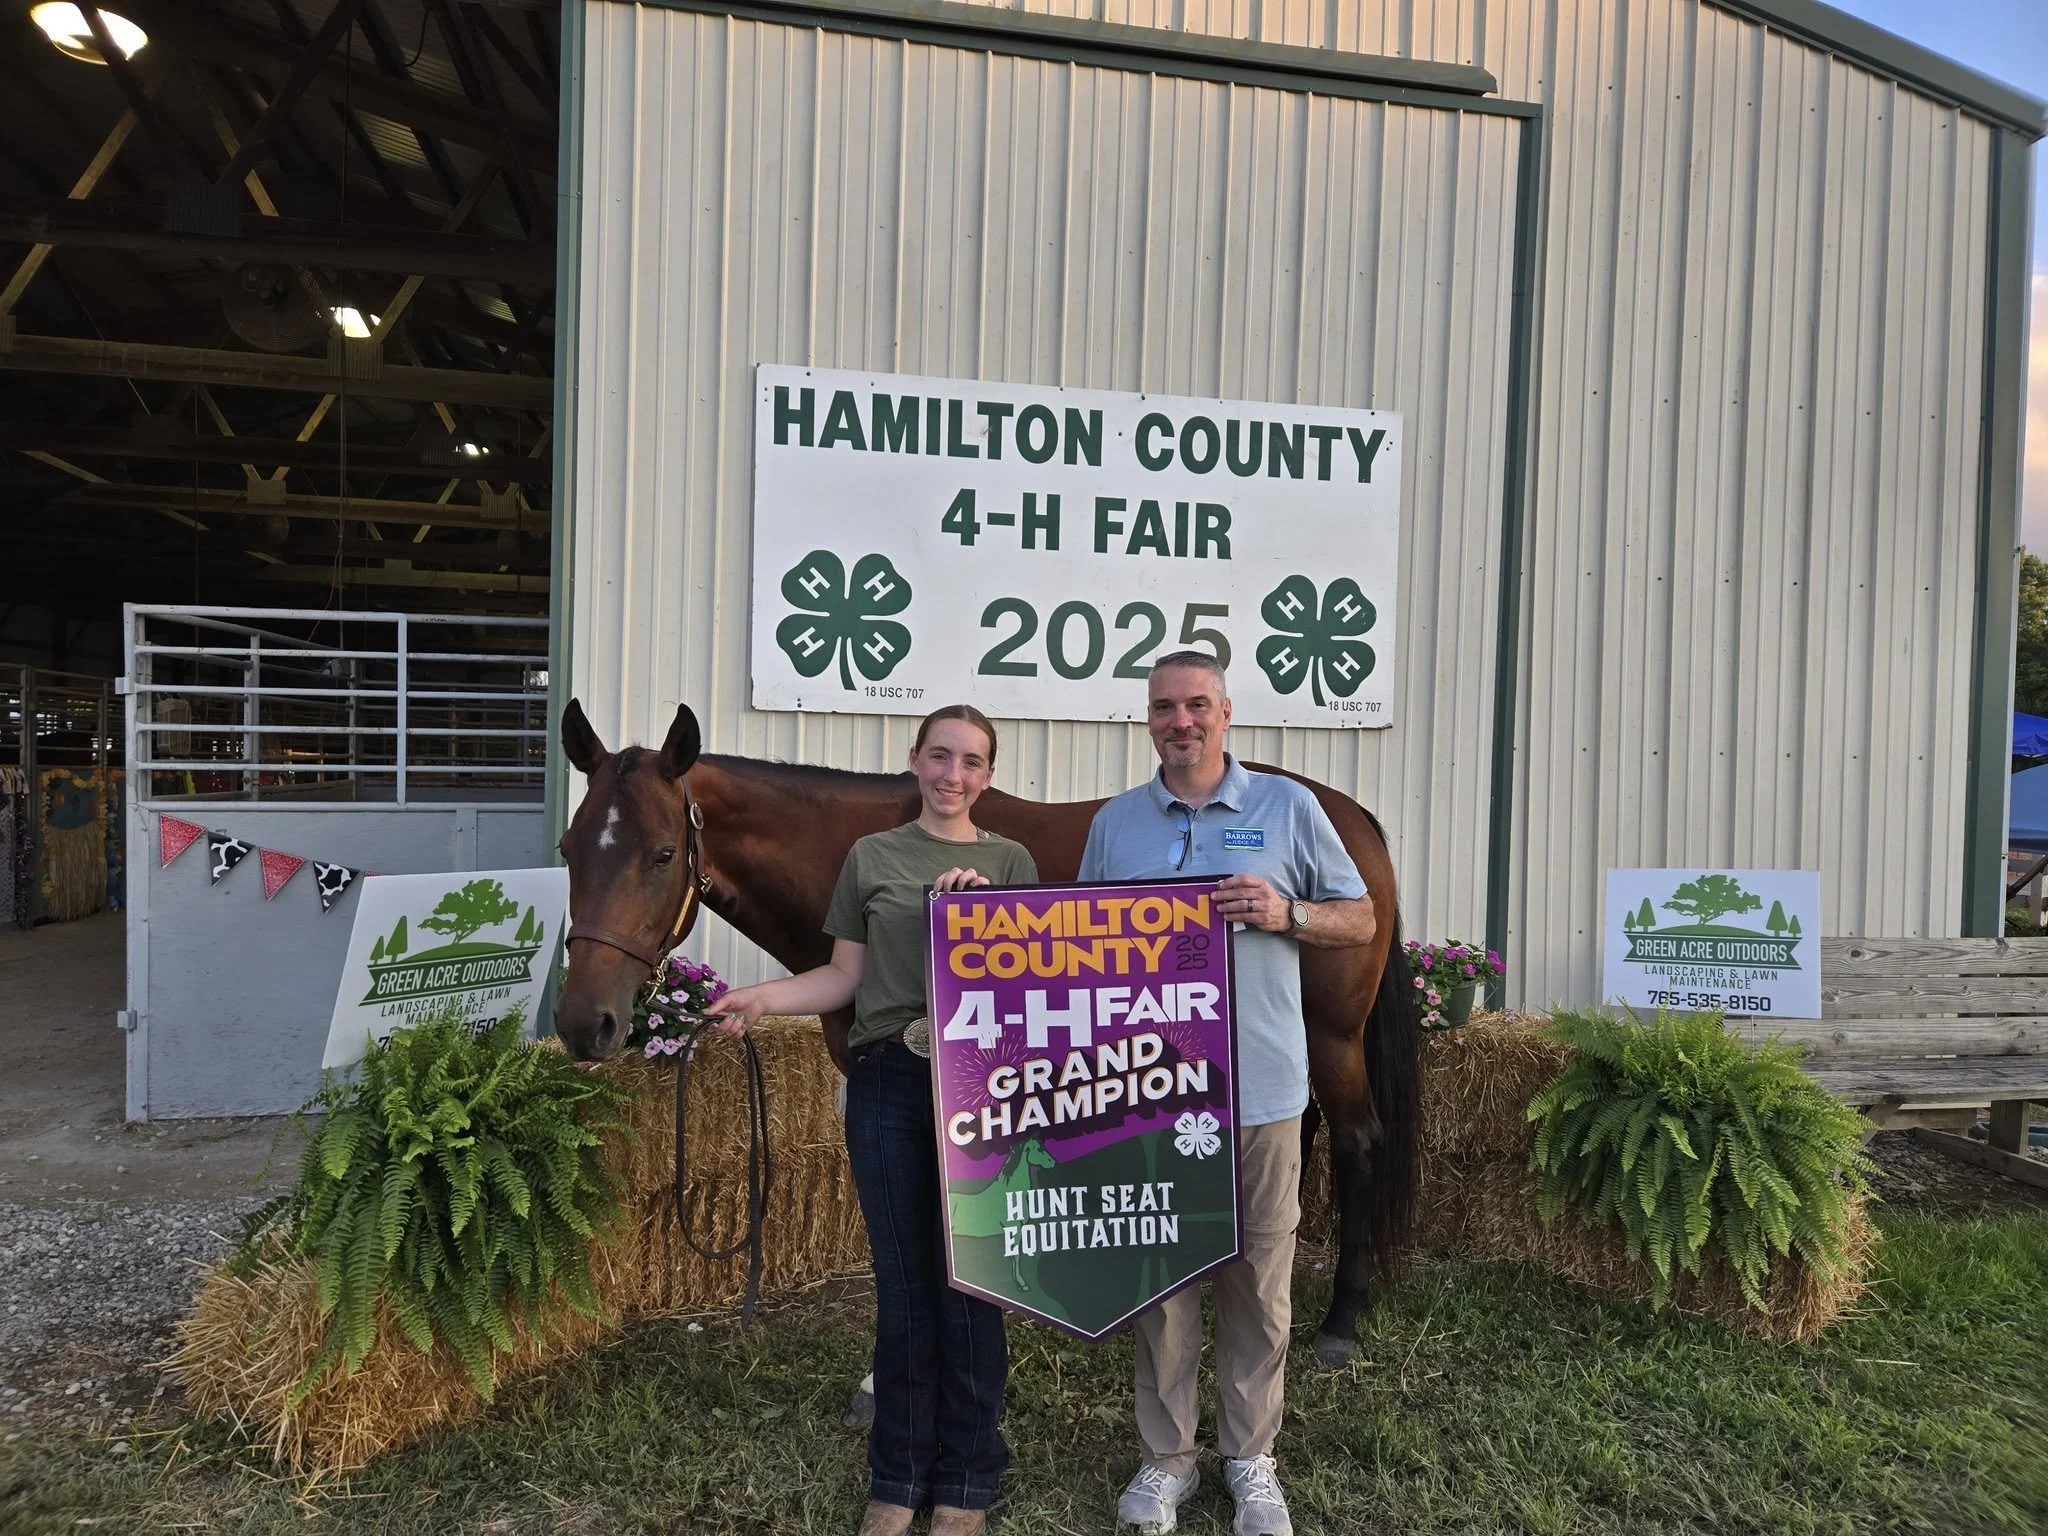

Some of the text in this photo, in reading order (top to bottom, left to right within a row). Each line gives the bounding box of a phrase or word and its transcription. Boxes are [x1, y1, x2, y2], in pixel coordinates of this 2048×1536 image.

[773, 385, 1387, 484] HAMILTON COUNTY
[941, 488, 1232, 560] 4-H FAIR
[798, 566, 896, 602] H H
[1276, 590, 1362, 623] H H
[792, 626, 895, 663] H H
[977, 597, 1232, 680] 2025
[1270, 646, 1361, 680] H H
[864, 686, 924, 699] 18 USC 707
[1328, 701, 1382, 712] 18 USC 707
[1225, 832, 1262, 841] BARROWS
[946, 894, 1210, 940] HAMILTON
[949, 933, 1210, 979] COUNTY 20
[1176, 953, 1209, 972] 25
[1636, 939, 1788, 962] GREEN ACRE OUTDOORS
[376, 955, 527, 995] GREEN ACRE OUTDOORS
[1644, 964, 1778, 981] LANDSCAPING & LAWN
[1669, 975, 1751, 990] MAINTENANCE
[381, 986, 512, 1017] LANDSCAPING & LAWN
[405, 1001, 486, 1026] MAINTANCE
[943, 982, 1220, 1050] 4-H FAIR
[1648, 990, 1771, 1012] 765-535-8150
[986, 1032, 1164, 1099] GRAND
[947, 1059, 1209, 1146] CHAMPION
[1005, 1182, 1174, 1222] HUNT SEAT
[1002, 1214, 1180, 1257] EQUITATION
